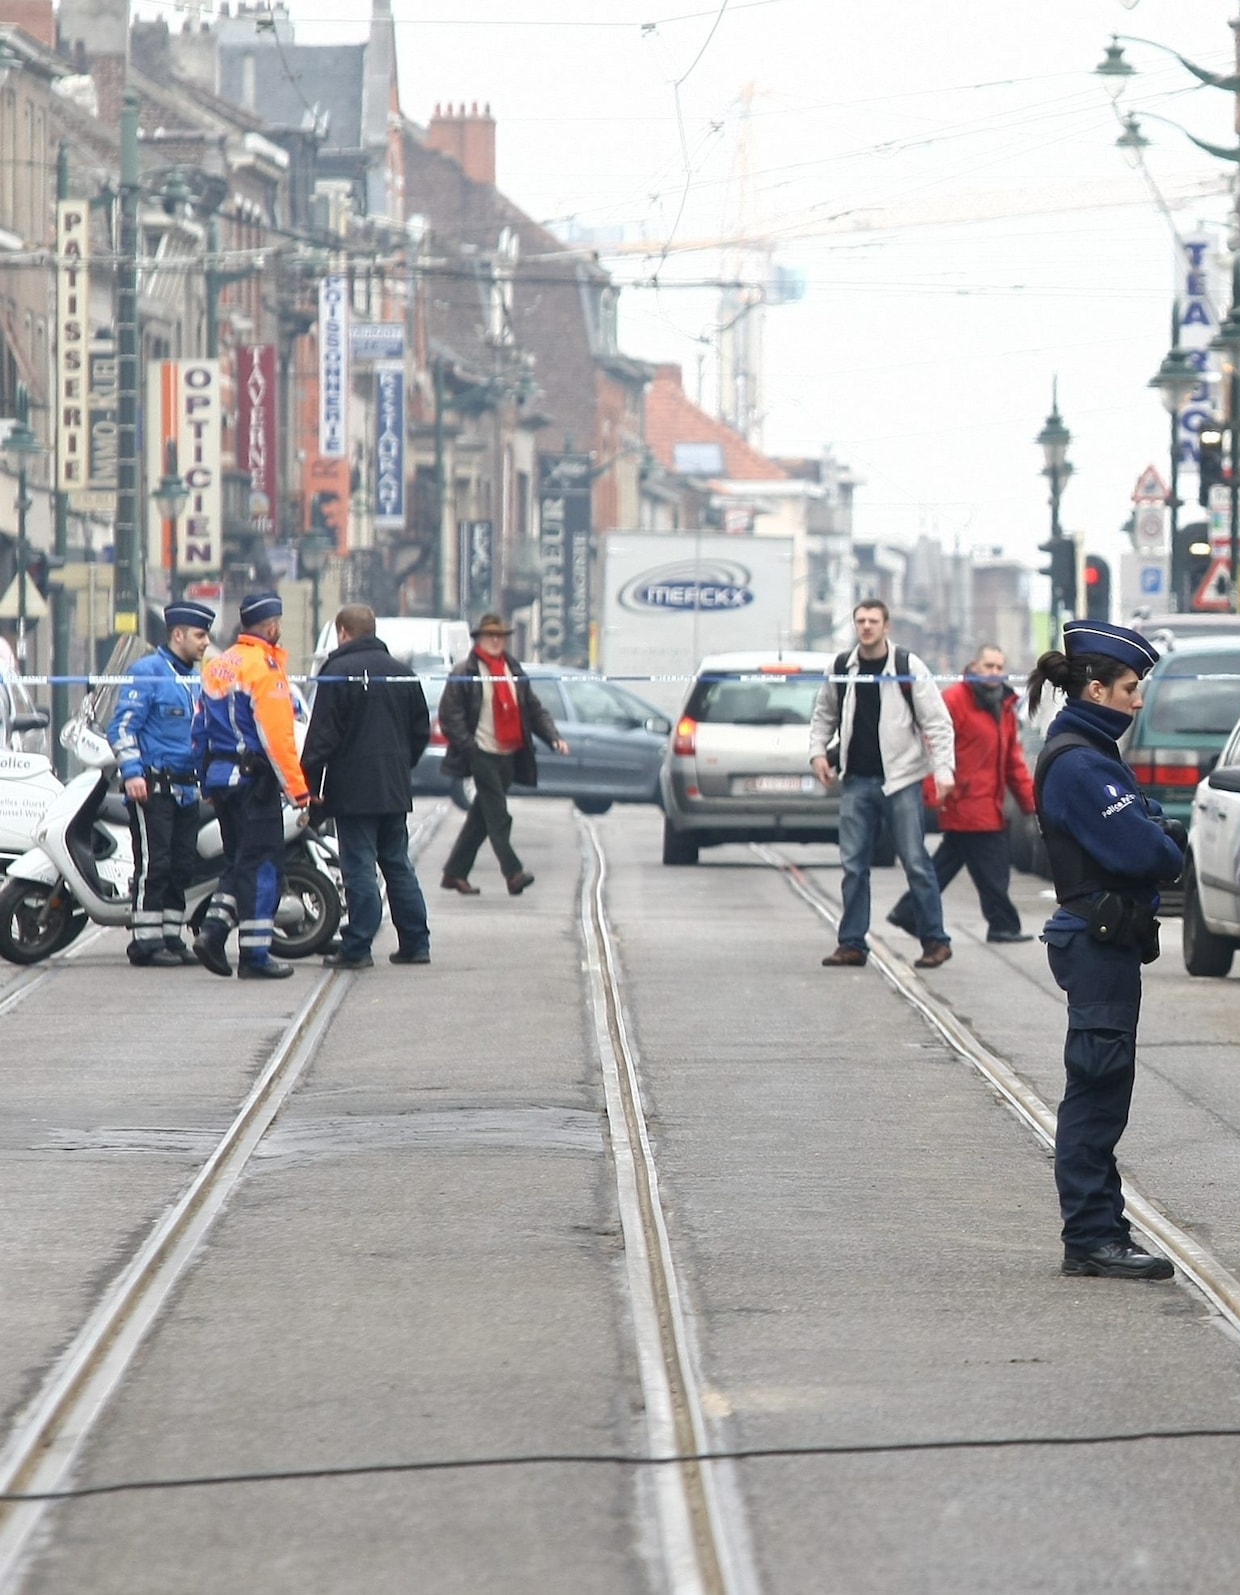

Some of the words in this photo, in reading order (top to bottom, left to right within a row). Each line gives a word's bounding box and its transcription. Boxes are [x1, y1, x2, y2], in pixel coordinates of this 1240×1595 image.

[63, 212, 82, 481] PATISSERIE
[1181, 243, 1211, 325] TEA
[183, 368, 212, 563] OPTICIEN
[246, 344, 266, 491] TAVERNE
[647, 585, 747, 607] MERCKX
